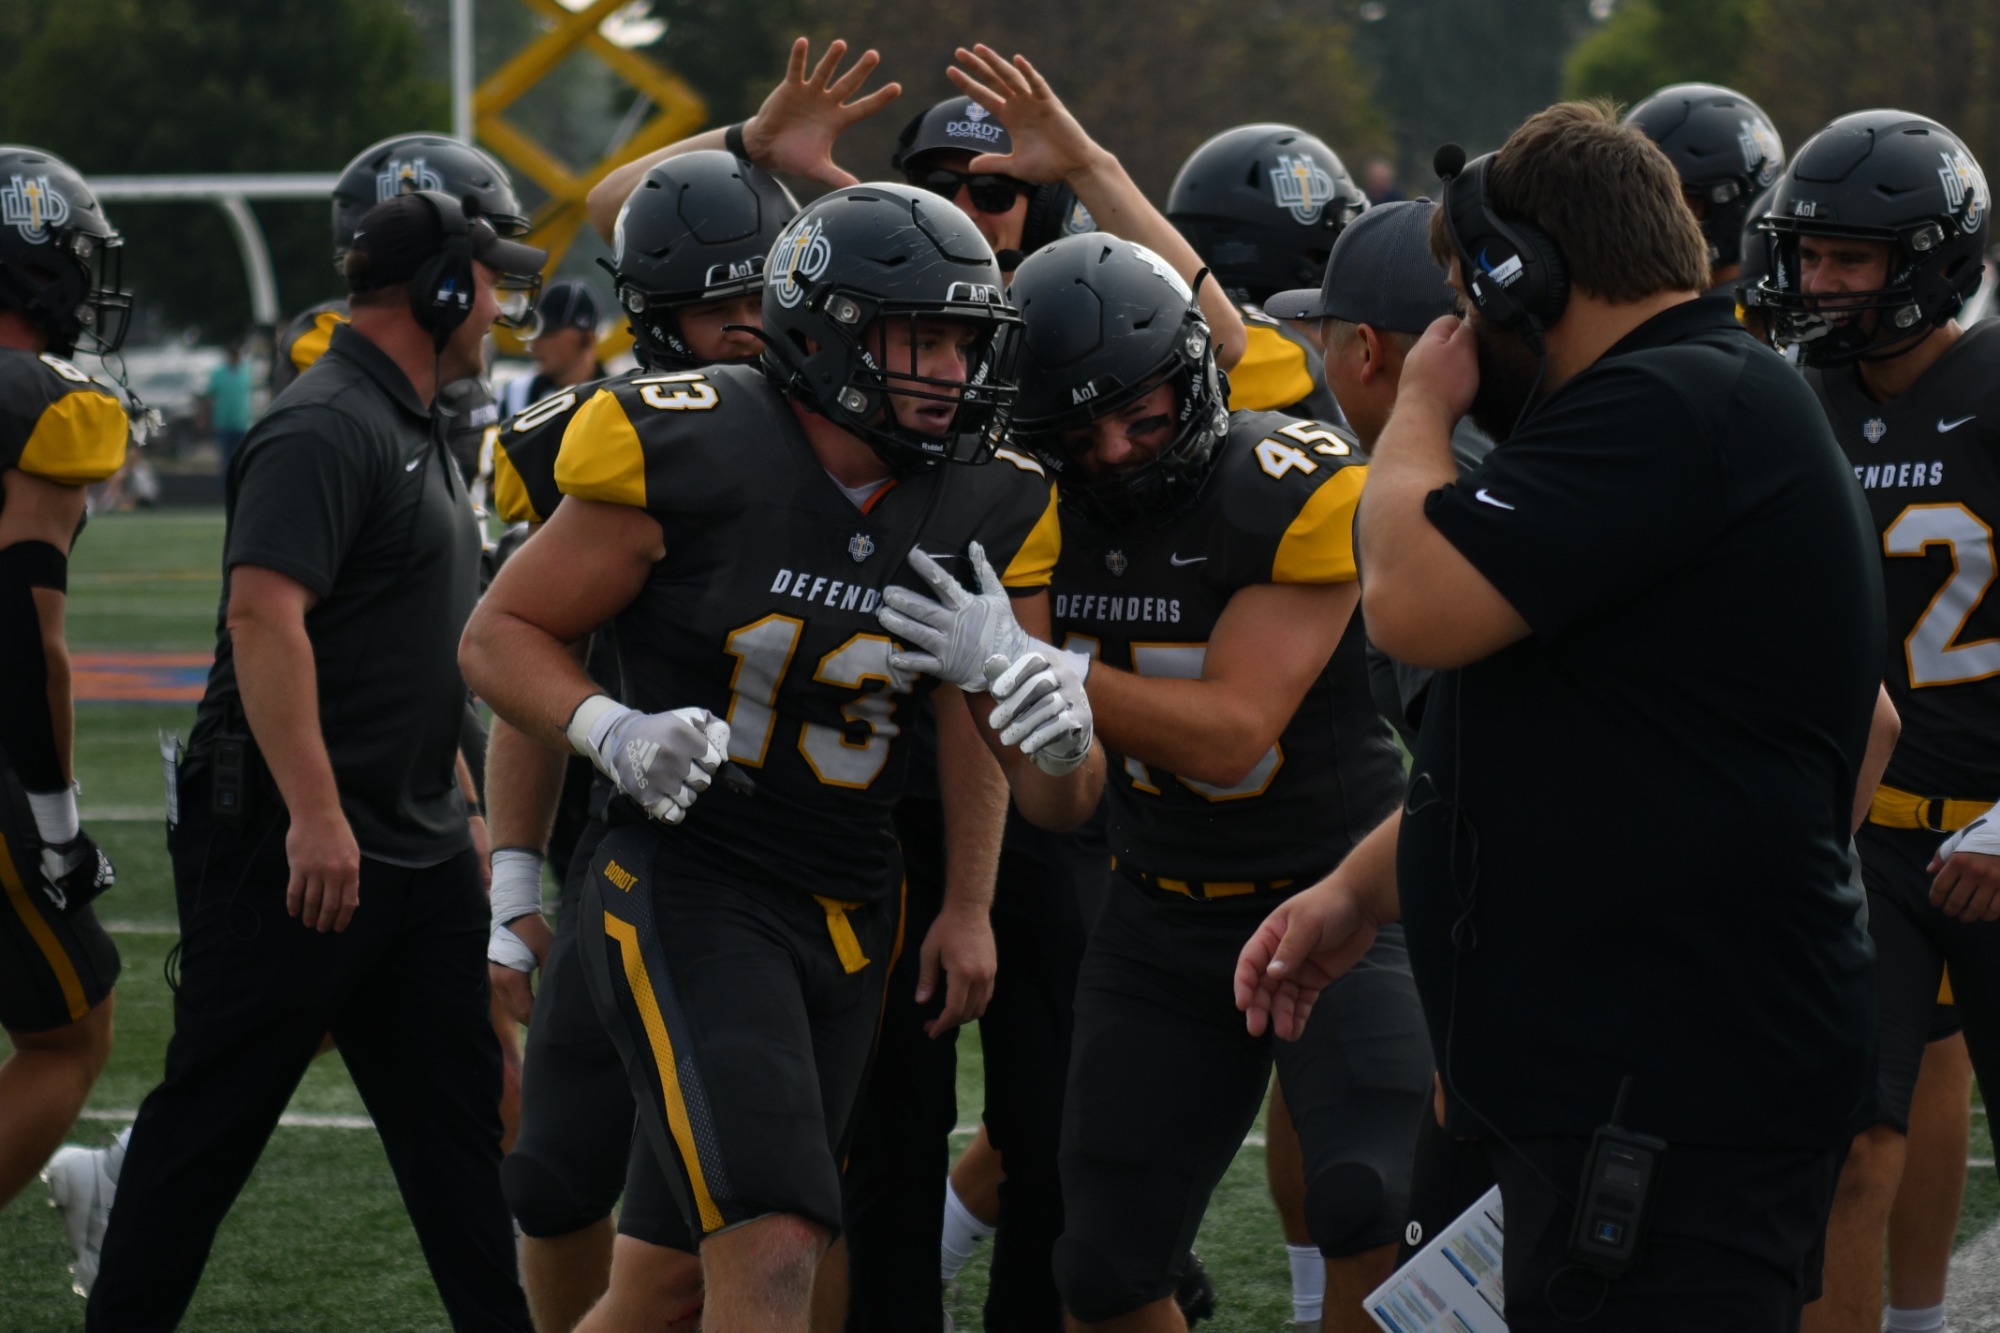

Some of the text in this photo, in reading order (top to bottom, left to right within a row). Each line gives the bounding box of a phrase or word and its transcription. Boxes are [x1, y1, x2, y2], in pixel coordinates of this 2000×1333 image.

[946, 121, 1004, 139] DORDT
[630, 373, 720, 411] 13
[1252, 420, 1351, 481] 45
[769, 568, 883, 617] DEFEND
[1056, 594, 1182, 624] DEFENDERS
[722, 611, 906, 791] 13
[626, 740, 649, 790] adidas
[603, 857, 639, 893] DORDT
